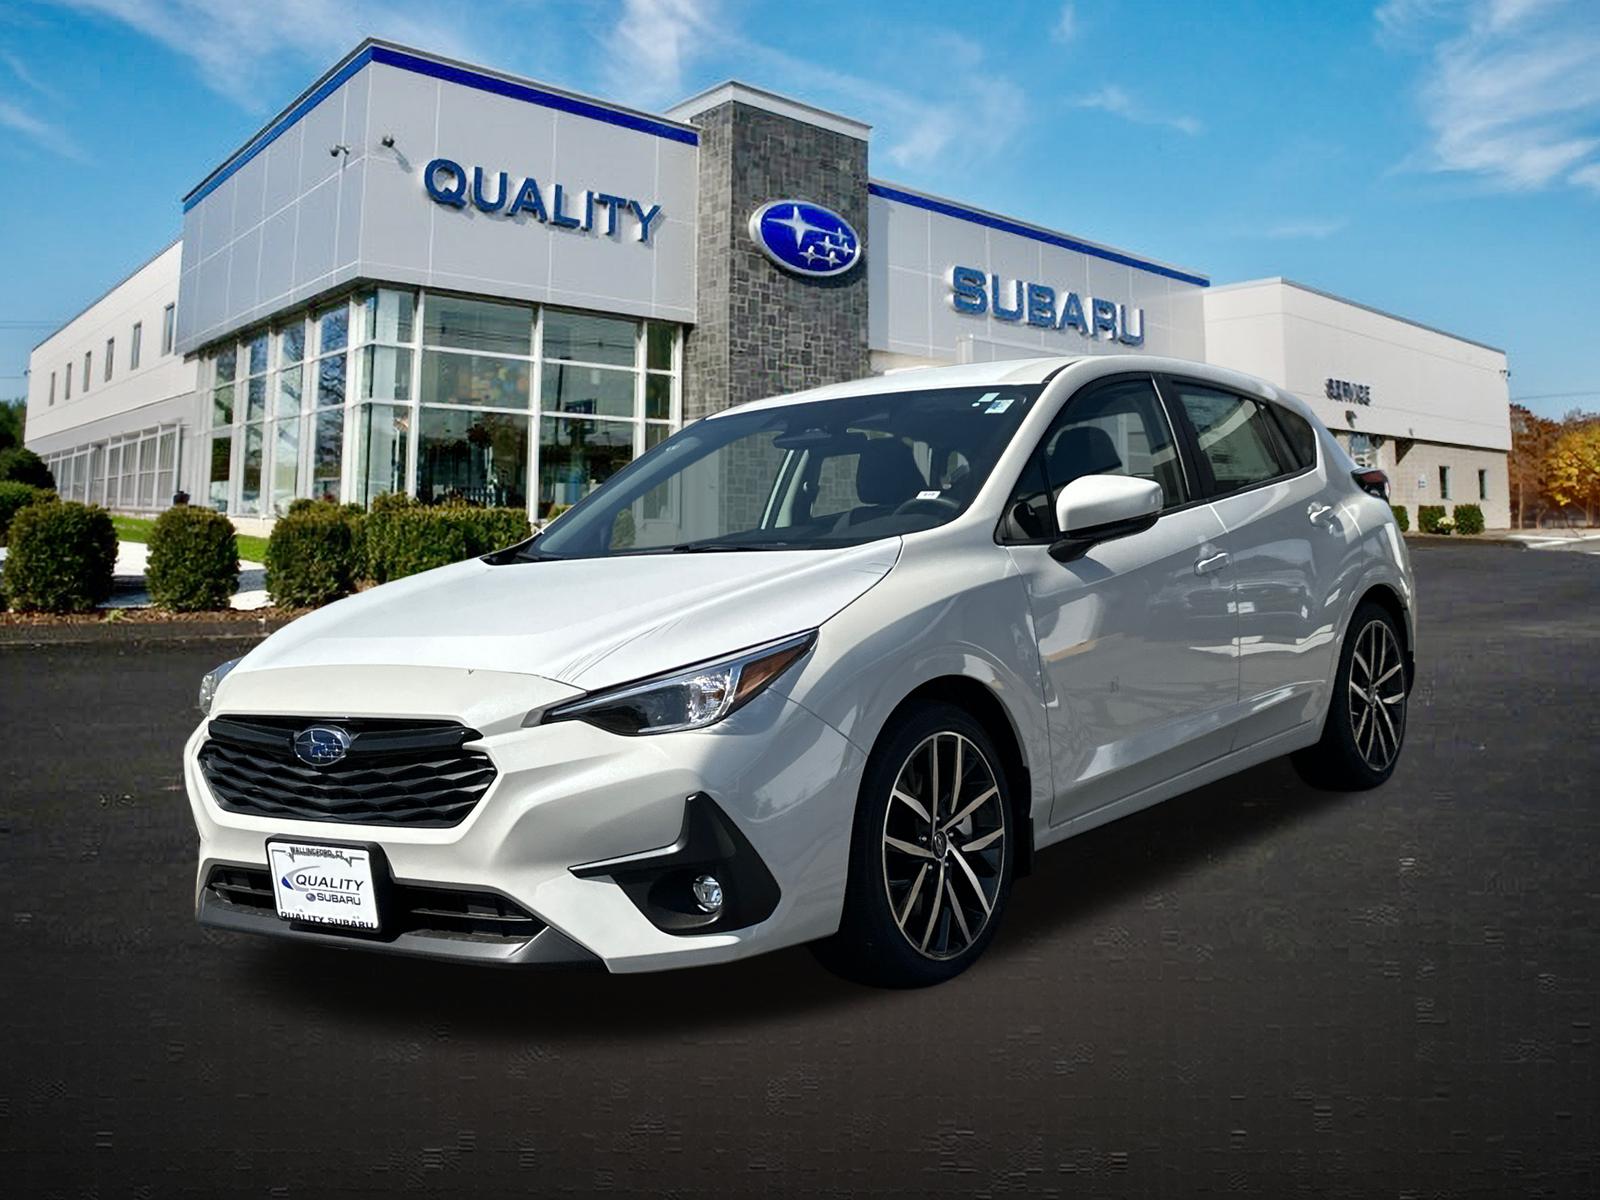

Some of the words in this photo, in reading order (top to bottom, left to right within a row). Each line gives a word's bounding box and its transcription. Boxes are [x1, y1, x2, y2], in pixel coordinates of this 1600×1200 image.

[424, 158, 661, 242] QUALITY
[951, 265, 1145, 346] SUBARU
[296, 874, 364, 891] QUALITY
[316, 893, 361, 906] SUBARU
[327, 916, 374, 929] SUBARU
